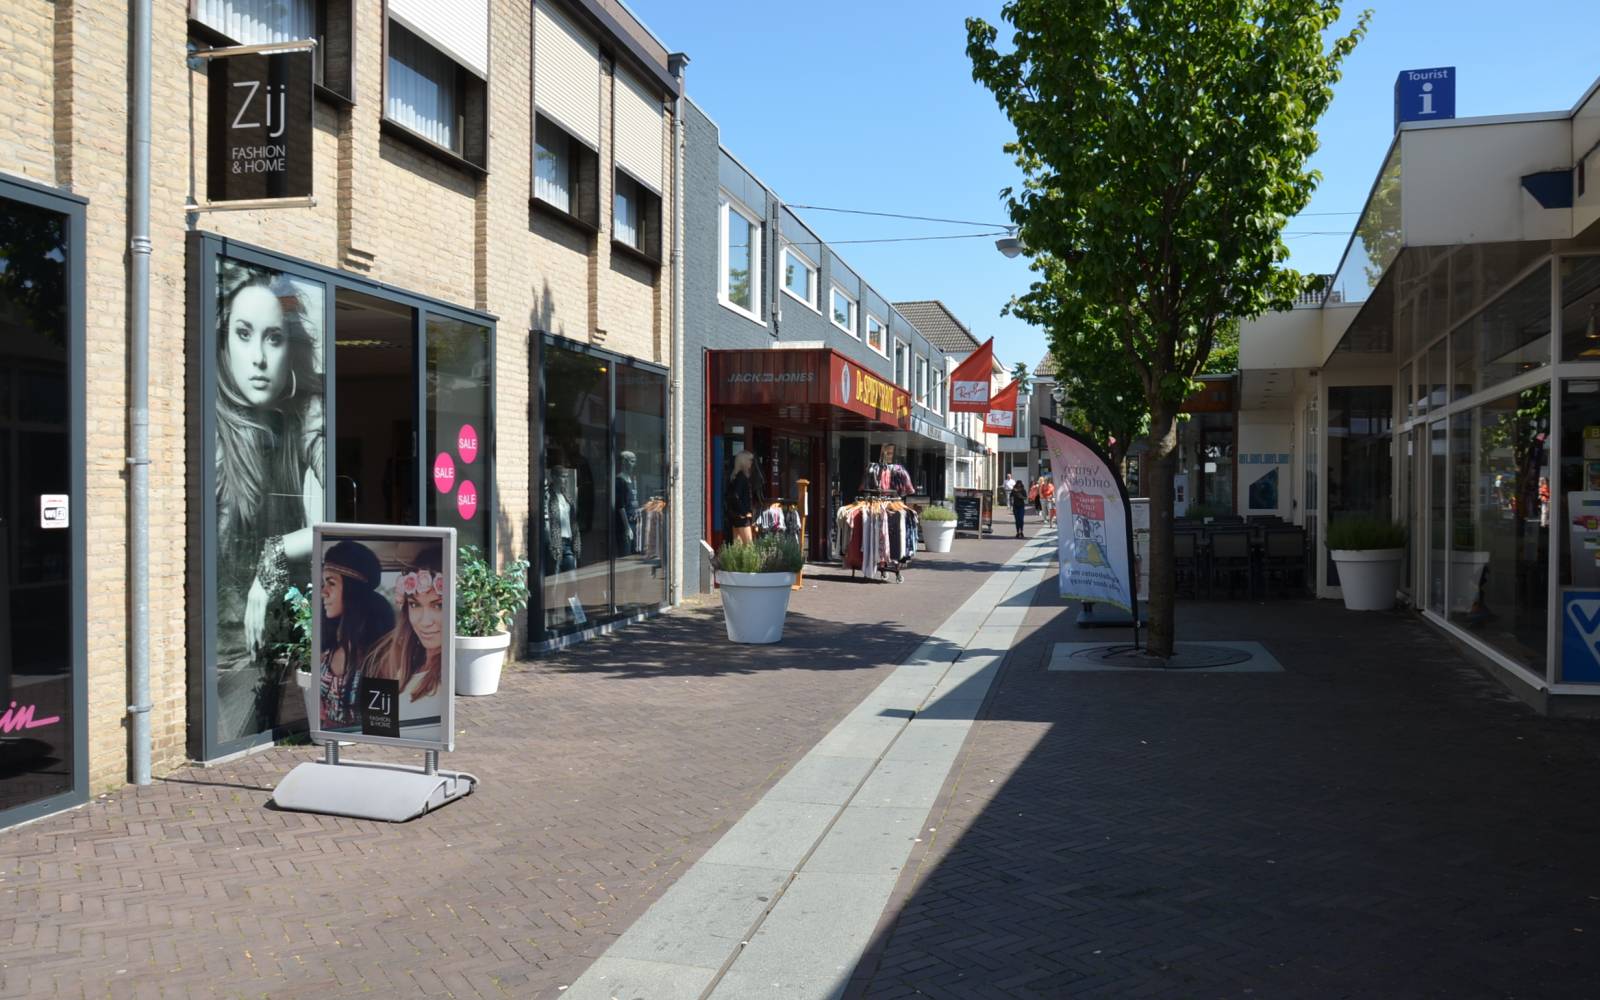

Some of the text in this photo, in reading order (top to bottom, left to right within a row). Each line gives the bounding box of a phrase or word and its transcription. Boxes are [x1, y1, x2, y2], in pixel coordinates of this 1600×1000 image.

[1408, 70, 1448, 80] Tourist
[232, 81, 285, 138] Zij
[232, 145, 286, 160] FASHION
[232, 158, 286, 174] & HOME
[728, 372, 760, 383] JACK
[775, 372, 815, 383] JONES
[459, 438, 478, 450] SALE
[434, 467, 455, 479] SALE
[458, 494, 477, 506] SALE
[368, 690, 391, 715] Zij
